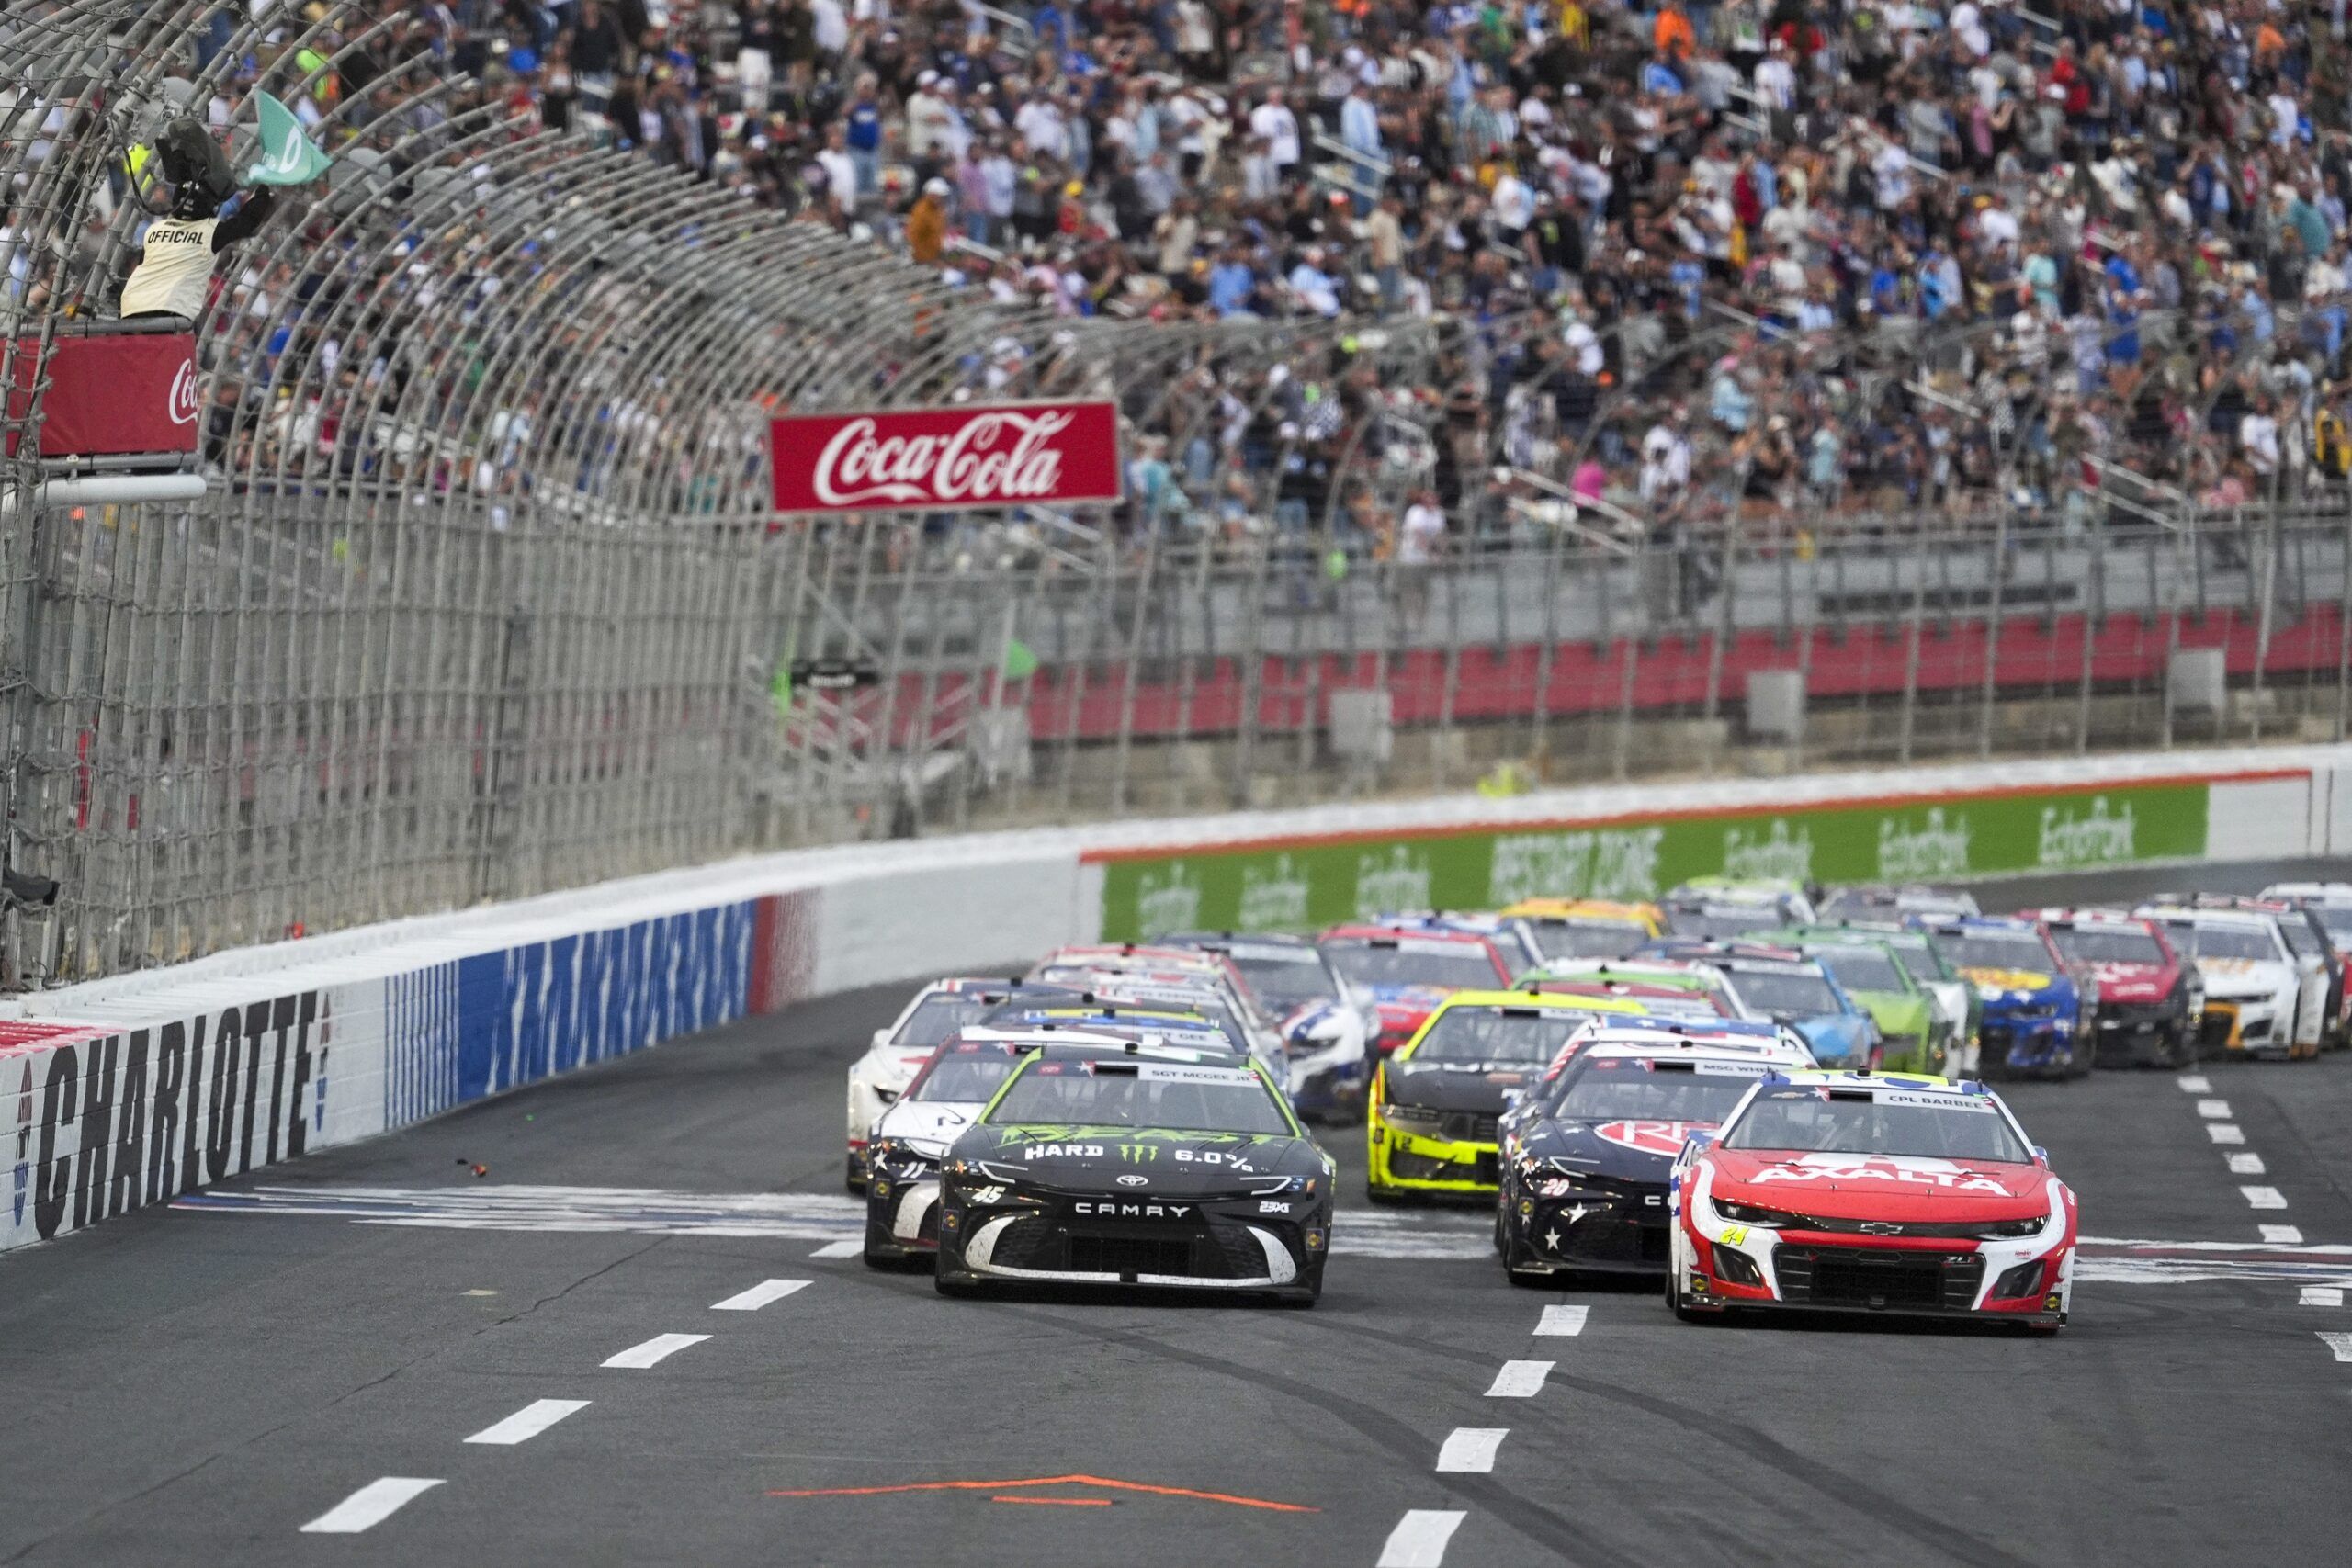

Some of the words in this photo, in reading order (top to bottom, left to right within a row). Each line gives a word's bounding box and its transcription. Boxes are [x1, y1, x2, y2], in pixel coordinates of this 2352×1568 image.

[147, 230, 203, 245] OFFICIAL
[812, 409, 1077, 505] Coca-Cola
[1151, 1069, 1179, 1077] SGT
[1182, 1071, 1229, 1081] MCGEE
[1889, 1095, 1917, 1104] CPL
[1921, 1097, 1984, 1110] BARBEE
[35, 990, 318, 1241] CHARLOTTE
[1024, 1144, 1104, 1161] HARD
[1175, 1149, 1254, 1173] 6.0%
[1540, 1178, 1570, 1197] 20
[1749, 1168, 2013, 1198] AXALTA
[971, 1185, 1006, 1204] 45
[1075, 1201, 1191, 1218] CAMRY
[1719, 1225, 1749, 1246] 24
